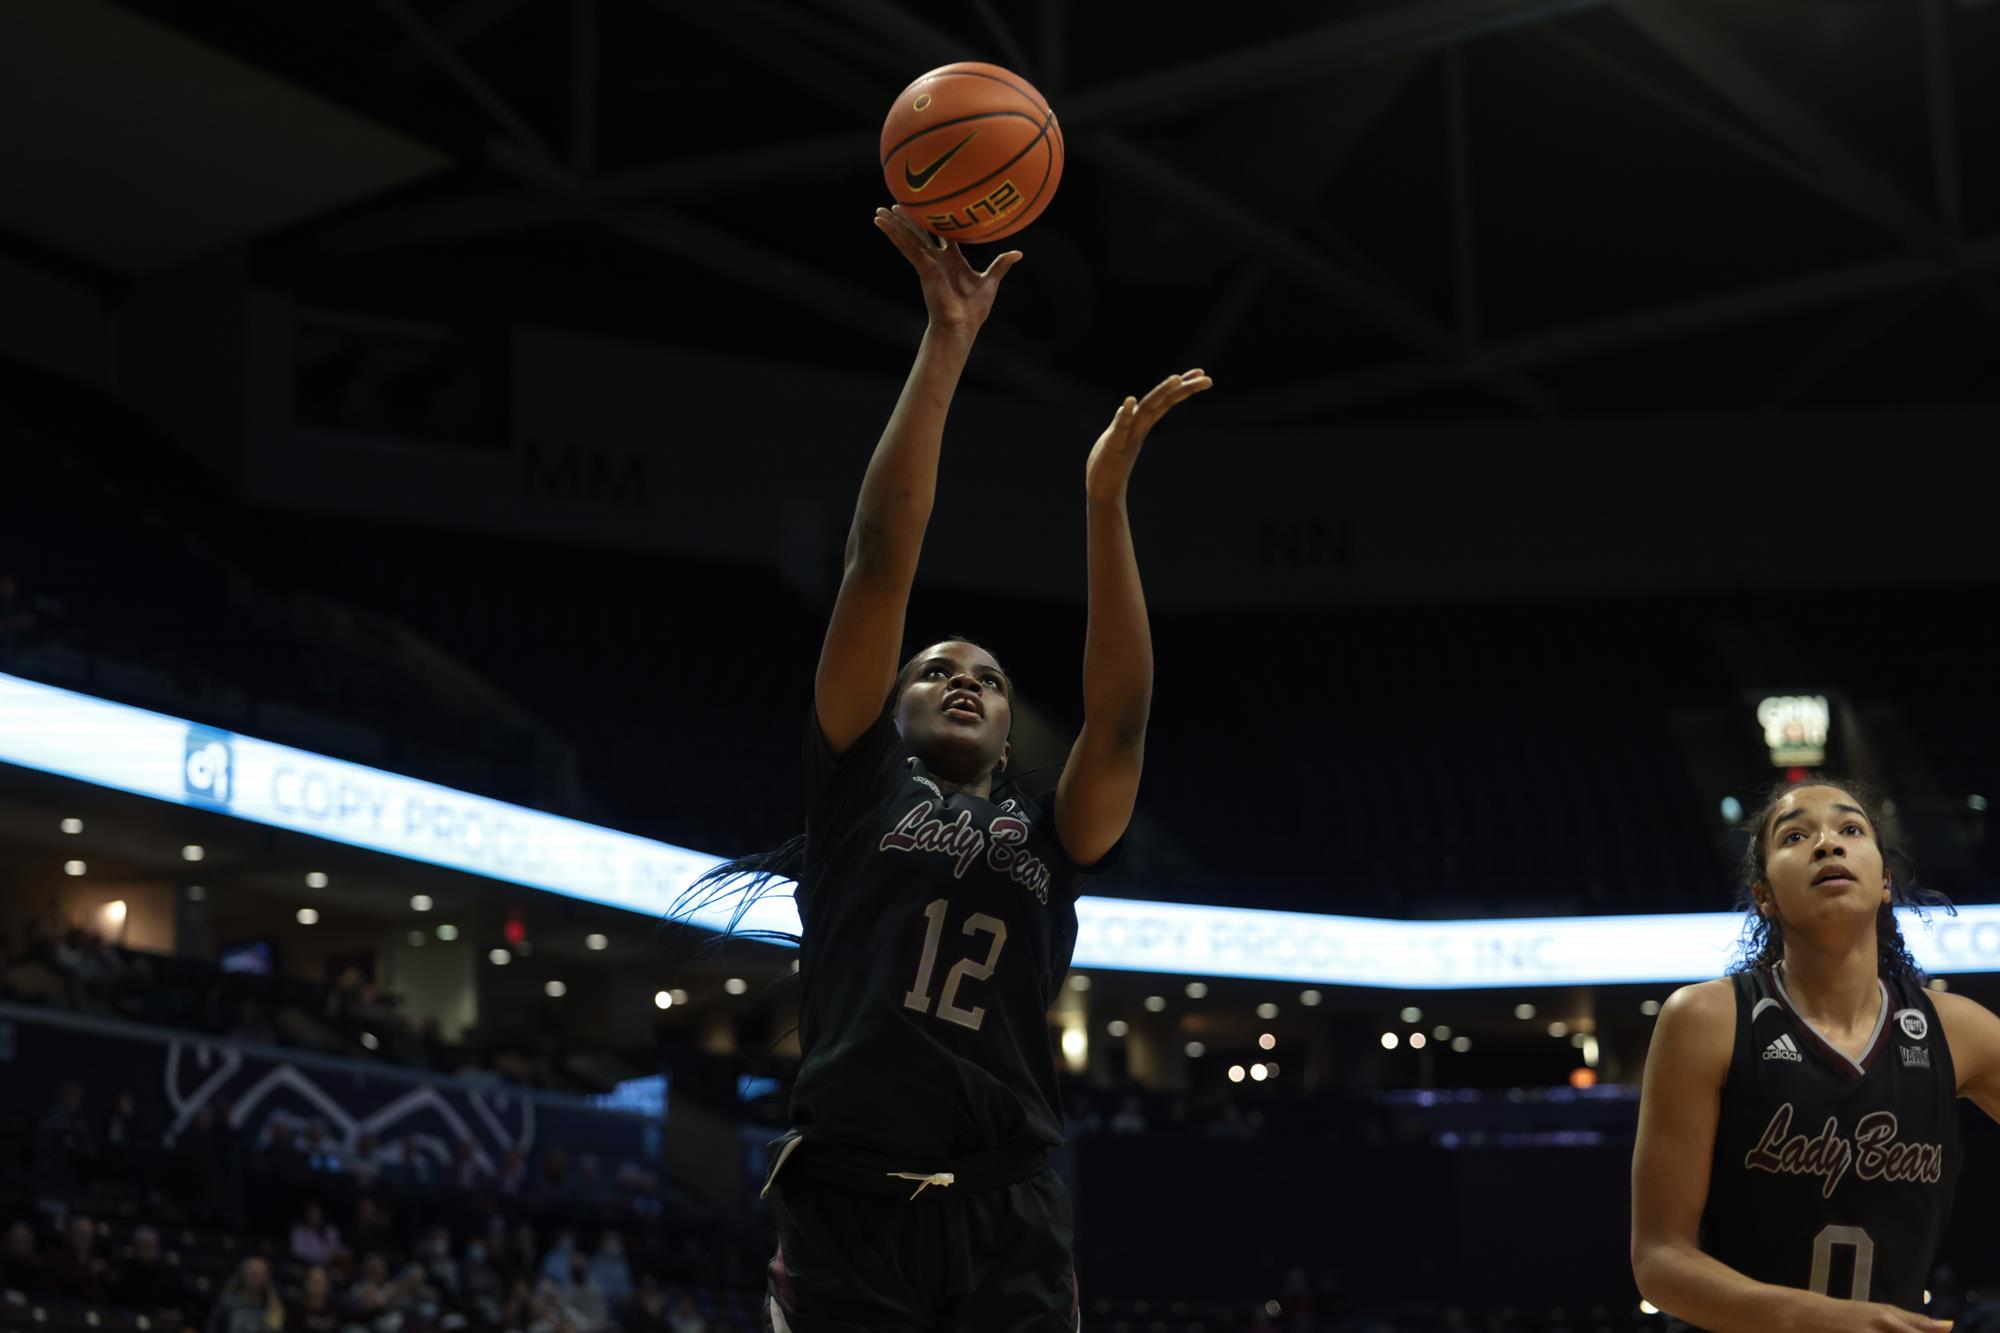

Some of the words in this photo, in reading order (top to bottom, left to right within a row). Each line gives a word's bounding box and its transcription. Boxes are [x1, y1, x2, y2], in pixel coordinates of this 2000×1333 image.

[926, 180, 1021, 232] ELITE
[522, 438, 648, 506] MM
[1259, 516, 1352, 567] NN
[270, 763, 390, 832] COPY
[403, 793, 620, 888] PRODU
[879, 800, 984, 879] Lady
[987, 816, 1050, 905] Bears
[904, 898, 1007, 1031] 12
[1206, 920, 1456, 975] PRODUTS
[1762, 1048, 1802, 1062] adidas
[1745, 1102, 1851, 1199] Lady
[1855, 1111, 1942, 1184] Bears
[1809, 1224, 1874, 1302] 0
